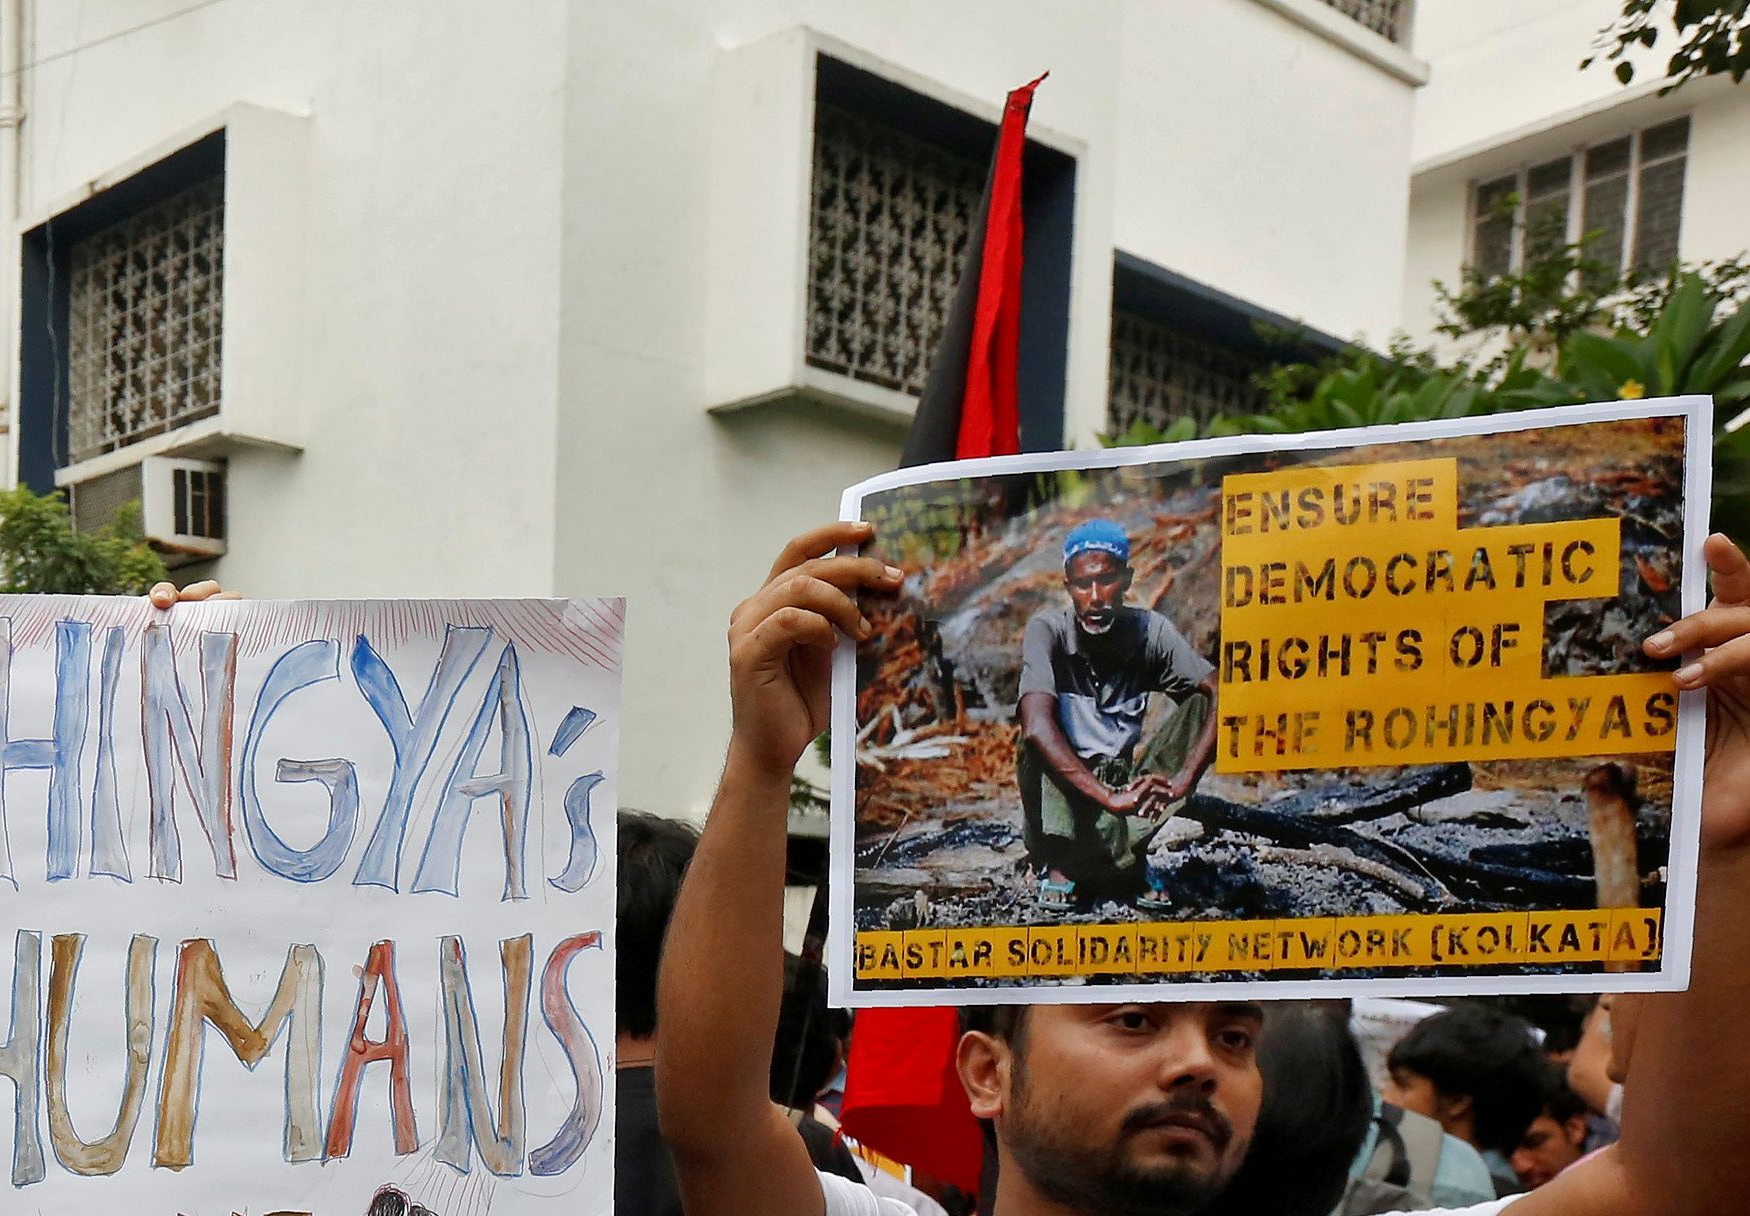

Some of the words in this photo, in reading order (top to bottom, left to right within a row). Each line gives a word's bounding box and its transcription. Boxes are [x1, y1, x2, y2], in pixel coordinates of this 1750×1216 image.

[1226, 477, 1434, 535] ENSURE
[1226, 540, 1595, 608] DEMOCRATIC
[1223, 629, 1424, 684] RIGHTS
[1452, 622, 1520, 668] OF
[1223, 711, 1320, 758] THE
[1345, 692, 1674, 752] ROHINGYAS
[858, 940, 993, 970] BASTAR
[1008, 933, 1211, 966] SOLIDARITY
[1228, 928, 1414, 961] NETWORK
